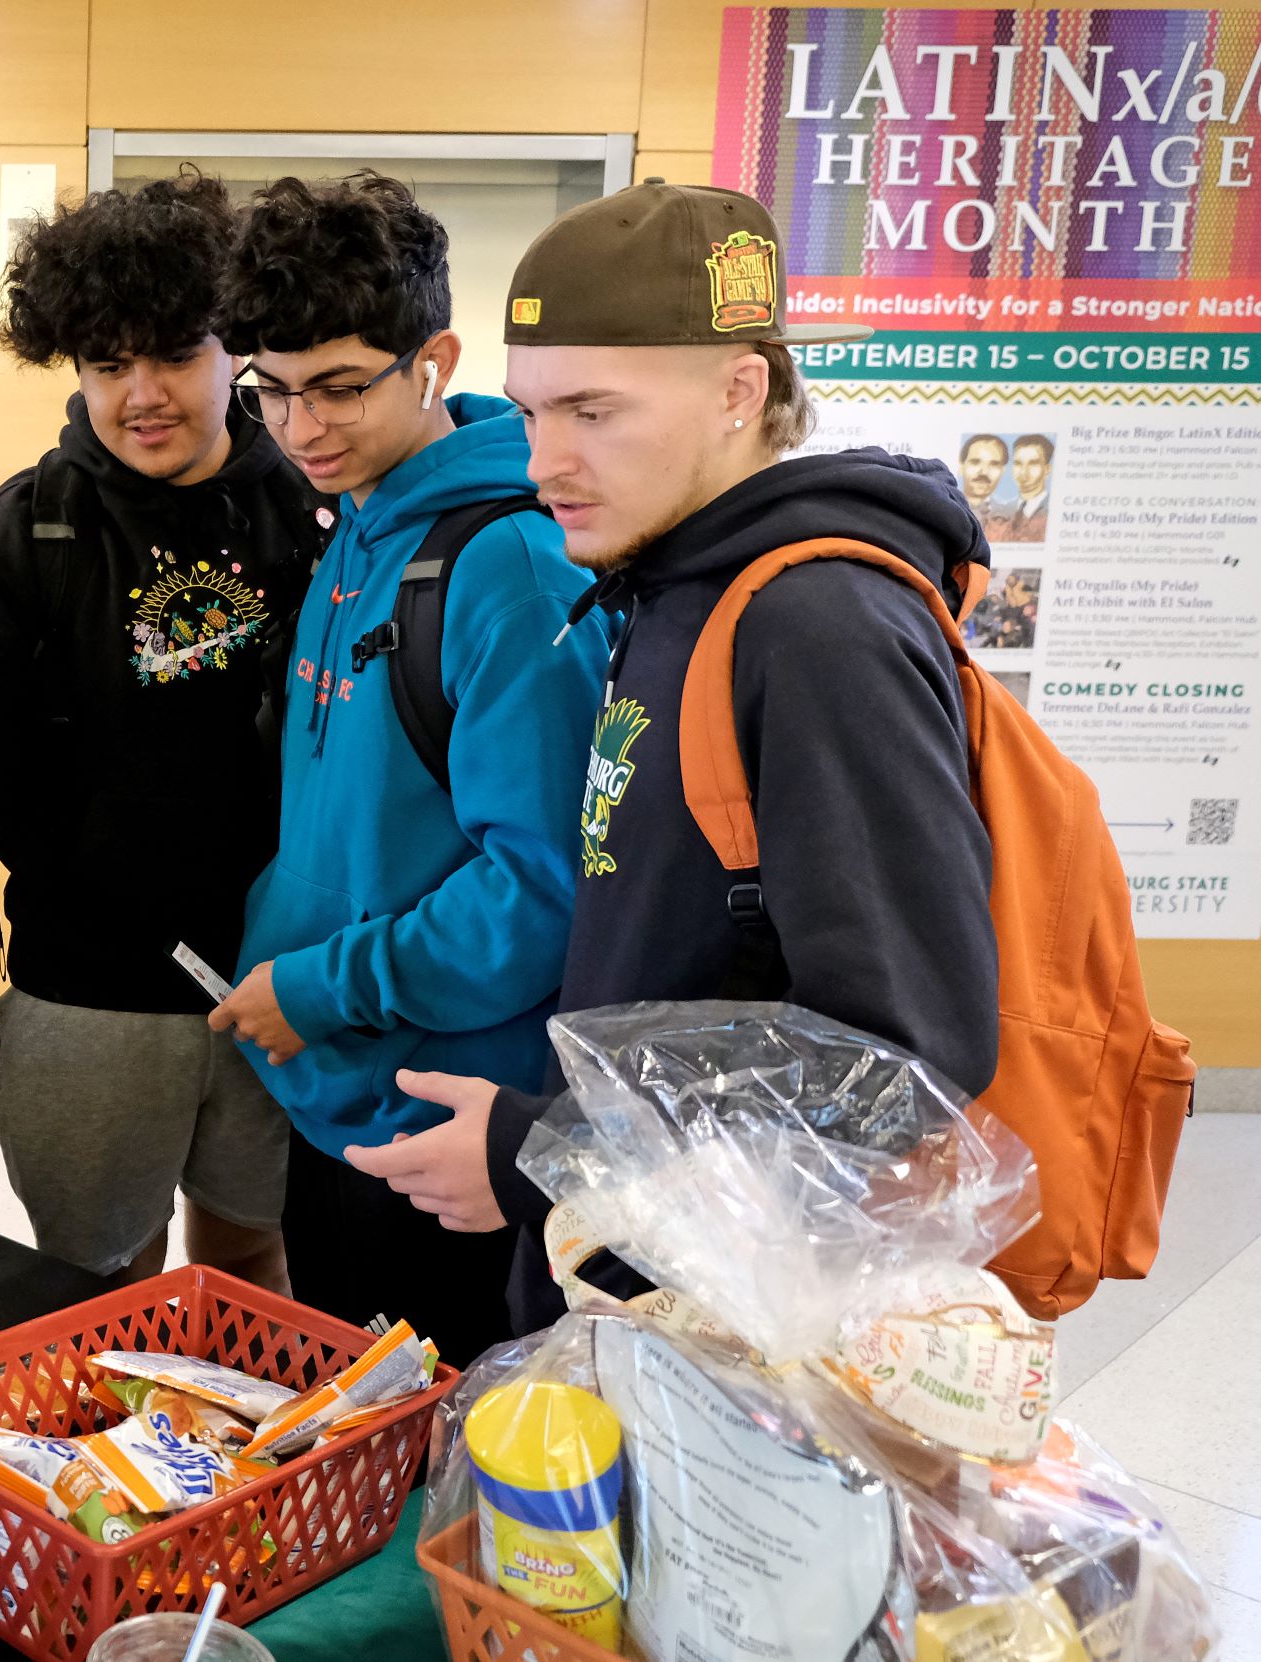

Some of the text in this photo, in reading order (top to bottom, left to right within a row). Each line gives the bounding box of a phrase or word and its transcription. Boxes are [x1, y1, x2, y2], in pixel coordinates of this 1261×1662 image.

[784, 41, 1261, 124] LATINx/a/
[812, 133, 1255, 188] HERITAGE
[866, 199, 1191, 252] MONTH
[786, 291, 845, 313] nido:
[853, 293, 993, 320] Inclusivity
[1001, 295, 1040, 316] for
[1047, 299, 1063, 316] a
[1071, 296, 1191, 321] Stronger
[787, 343, 1250, 370] SEPTEMBER 15 OCTOBER 15
[1071, 426, 1092, 440] Big
[1096, 426, 1129, 438] Prize
[1133, 426, 1173, 441] Bingo:
[1179, 427, 1222, 439] LatinX
[887, 442, 914, 453] Talk
[1166, 446, 1221, 455] Hammond
[1224, 446, 1257, 455] Falcon
[1063, 496, 1131, 507] CAFECITO
[1062, 512, 1258, 527] Mi Orgullo (My Pride) Edition
[1148, 531, 1203, 540] Hammond
[1054, 579, 1199, 593] Mi Orgullo (My Pride)
[1053, 597, 1074, 608] Art
[1077, 597, 1124, 608] Exhibit
[1127, 597, 1156, 608] with
[1177, 598, 1213, 609] Salon
[338, 678, 354, 702] FC
[1043, 682, 1245, 697] COMEDY CLOSING
[1042, 702, 1094, 713] Terrence
[1096, 702, 1145, 714] DeLane
[1147, 703, 1159, 714] &
[1192, 704, 1251, 715] Gonzalez
[1126, 876, 1229, 891] URG STATE
[1135, 894, 1227, 913] ERSITY
[263, 1417, 318, 1452] Nutrition Facts
[514, 1550, 576, 1577] BRING
[534, 1576, 586, 1600] FUN
